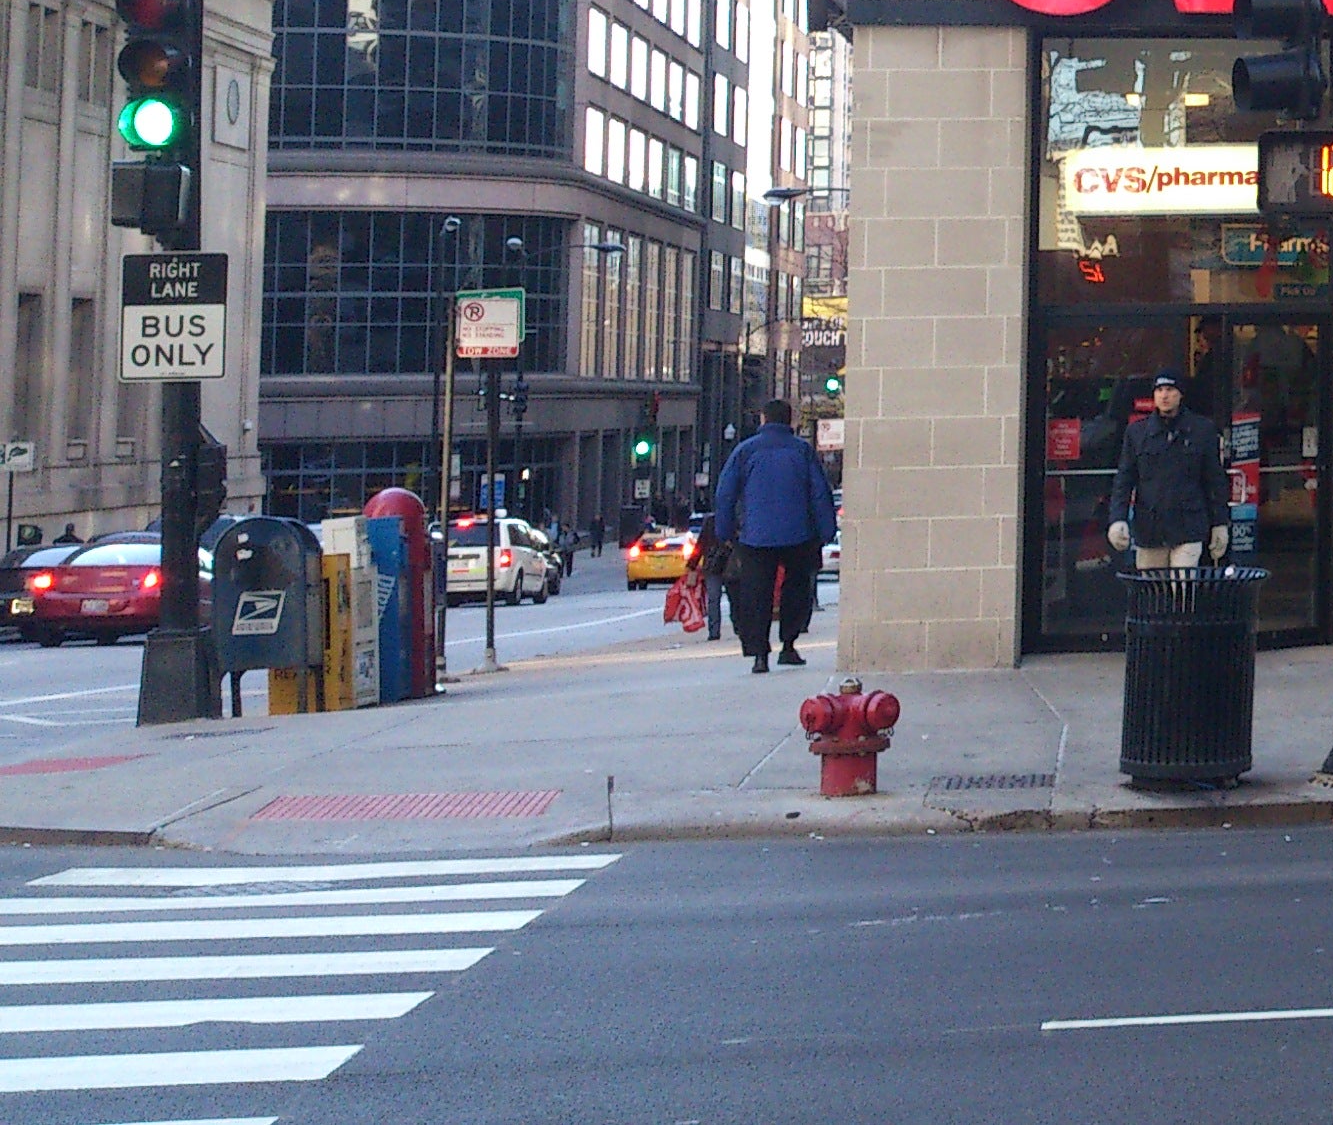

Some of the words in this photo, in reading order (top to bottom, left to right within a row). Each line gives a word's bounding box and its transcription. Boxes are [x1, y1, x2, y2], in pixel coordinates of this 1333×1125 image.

[1073, 166, 1258, 194] CVS/pharma
[149, 262, 201, 278] RIGHT
[151, 281, 199, 298] LANE
[141, 315, 206, 338] BUS
[131, 342, 215, 367] ONLY
